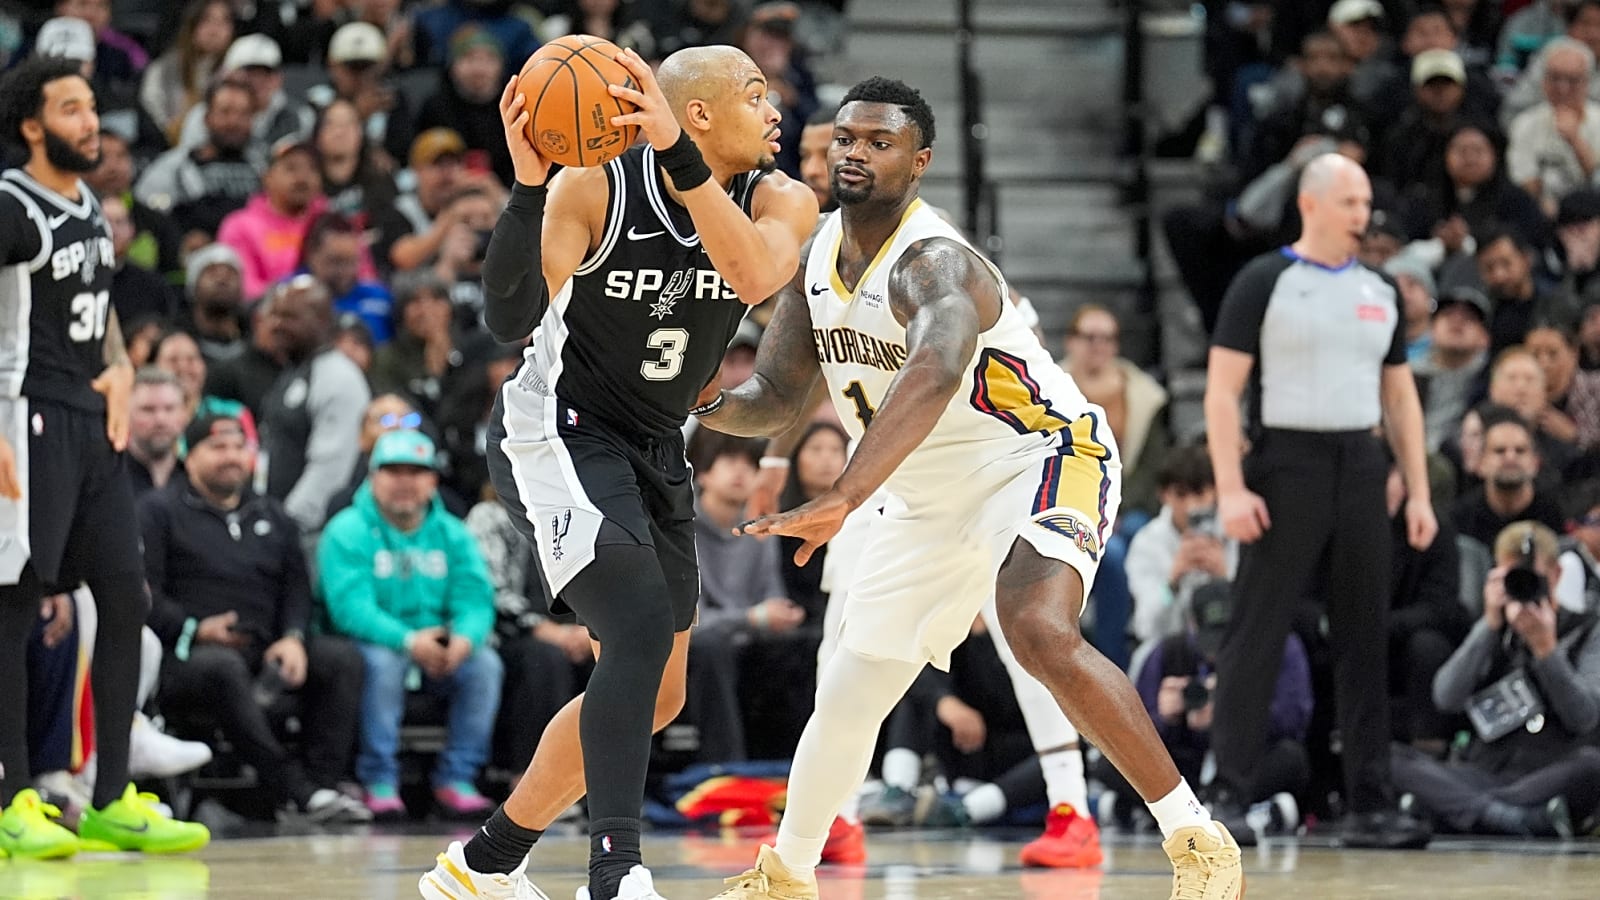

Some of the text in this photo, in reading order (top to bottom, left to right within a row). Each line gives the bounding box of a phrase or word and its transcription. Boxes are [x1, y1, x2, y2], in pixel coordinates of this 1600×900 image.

[51, 237, 115, 285] SPUR
[640, 328, 689, 380] 3
[842, 380, 875, 431] 1
